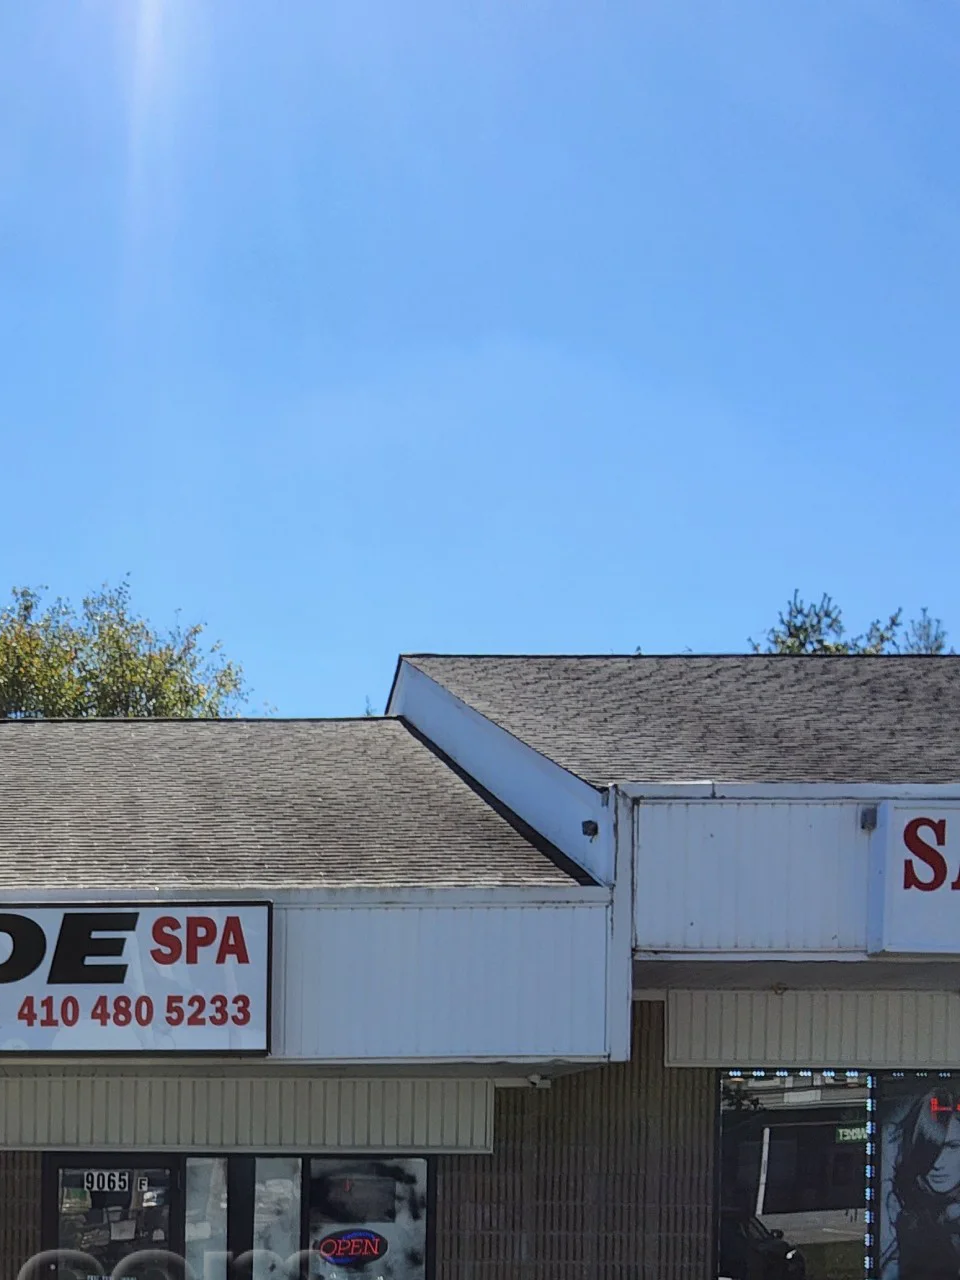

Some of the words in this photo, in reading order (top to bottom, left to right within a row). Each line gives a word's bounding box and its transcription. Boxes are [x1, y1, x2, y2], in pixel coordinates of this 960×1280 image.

[903, 817, 960, 891] S
[150, 916, 250, 965] SPA
[17, 995, 79, 1027] 410
[91, 995, 153, 1027] 480
[165, 994, 251, 1027] 5233
[85, 1172, 127, 1190] 9065
[139, 1178, 147, 1190] F
[320, 1237, 380, 1256] OPEN
